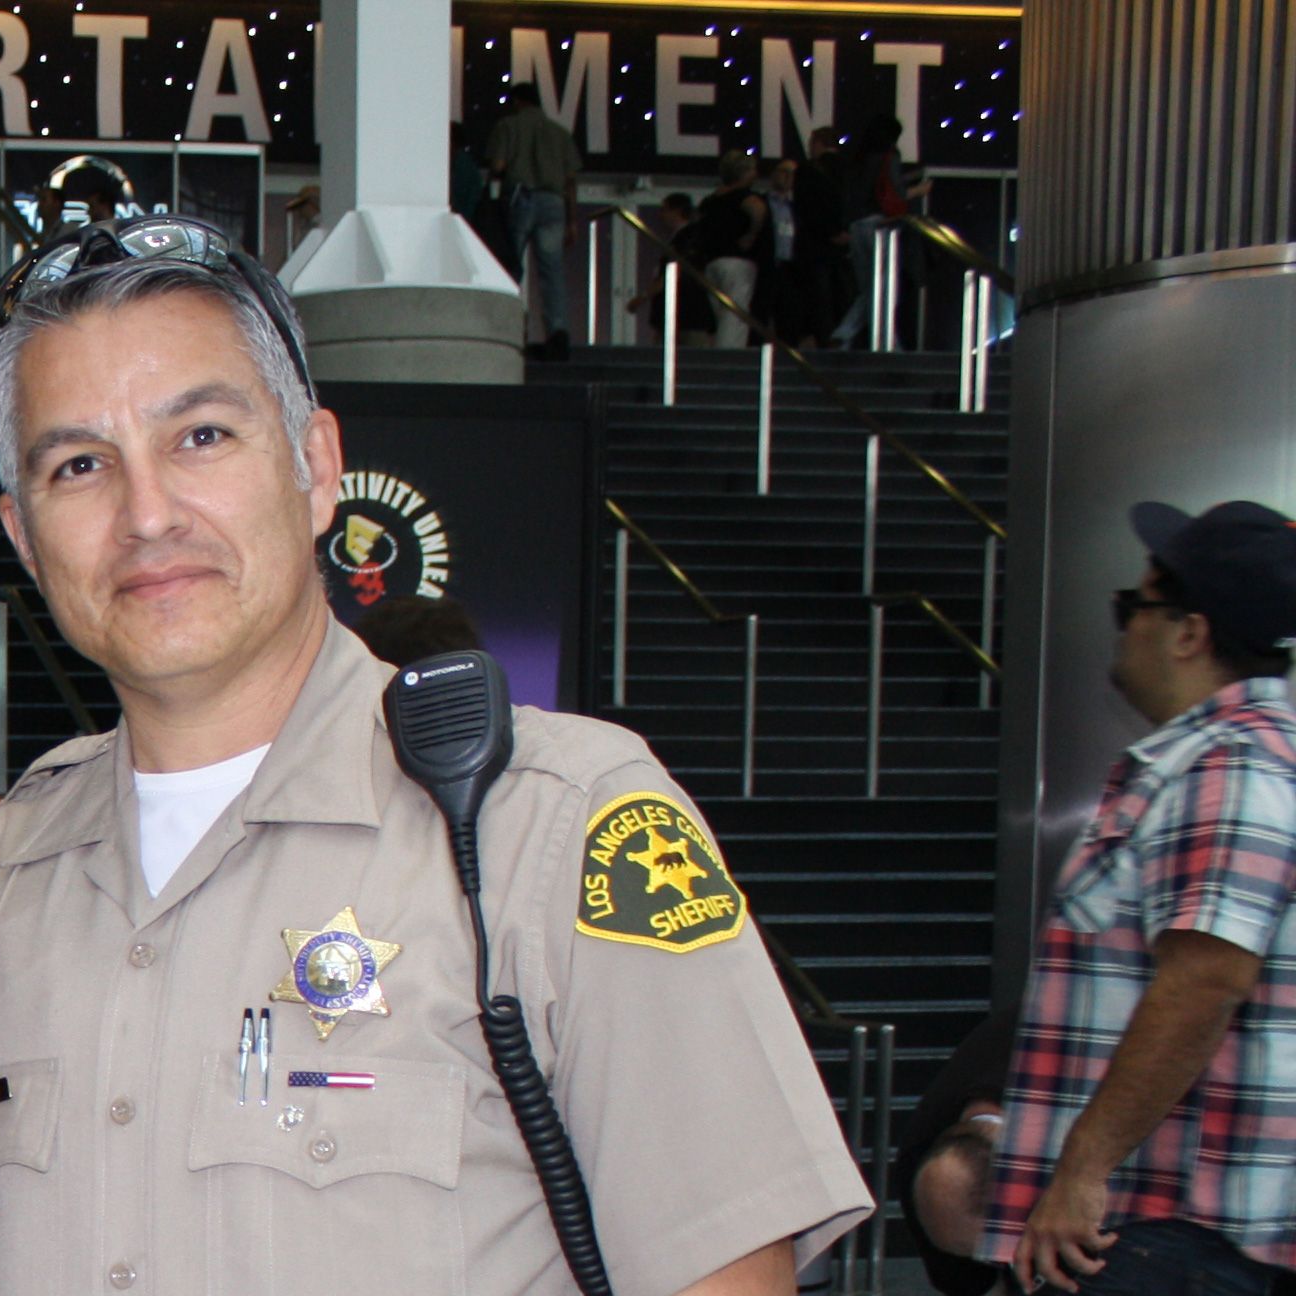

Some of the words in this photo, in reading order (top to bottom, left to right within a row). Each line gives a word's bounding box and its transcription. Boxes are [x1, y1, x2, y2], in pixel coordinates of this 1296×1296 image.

[412, 511, 450, 599] UNLEA
[589, 805, 672, 867] ANGELES
[585, 873, 615, 920] LOS
[649, 894, 735, 938] SHERIFF
